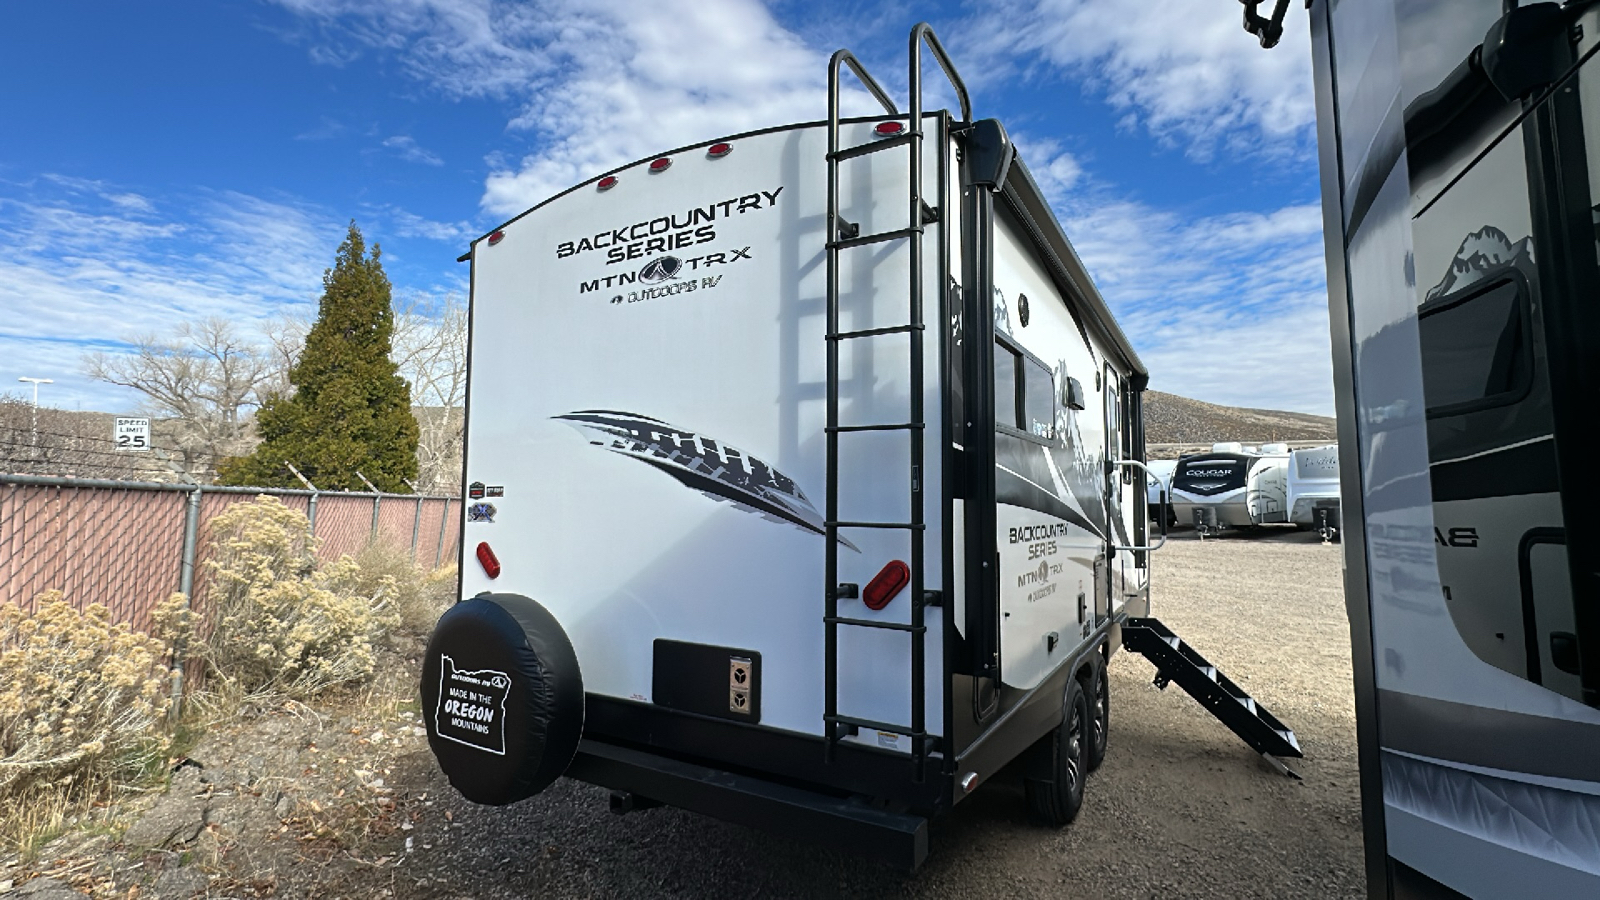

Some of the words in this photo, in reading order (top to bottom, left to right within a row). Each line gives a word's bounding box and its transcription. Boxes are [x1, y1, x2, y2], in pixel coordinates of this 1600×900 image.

[556, 187, 784, 259] BACKCOUNTRY
[606, 224, 716, 265] SERIES
[580, 272, 636, 294] MTN
[685, 246, 752, 270] TRX
[627, 279, 698, 304] OUTDOORS
[701, 274, 723, 289] RV
[118, 434, 146, 448] 25
[1009, 523, 1069, 544] BACKCOUNTRY
[1028, 540, 1058, 560] SERIES
[1018, 570, 1038, 588] MTN
[1049, 563, 1064, 576] TRX
[449, 687, 468, 699] MADE
[469, 689, 477, 701] IN
[478, 693, 492, 705] THE
[444, 699, 494, 722] OREGON
[451, 718, 489, 735] MOUNTAINS
